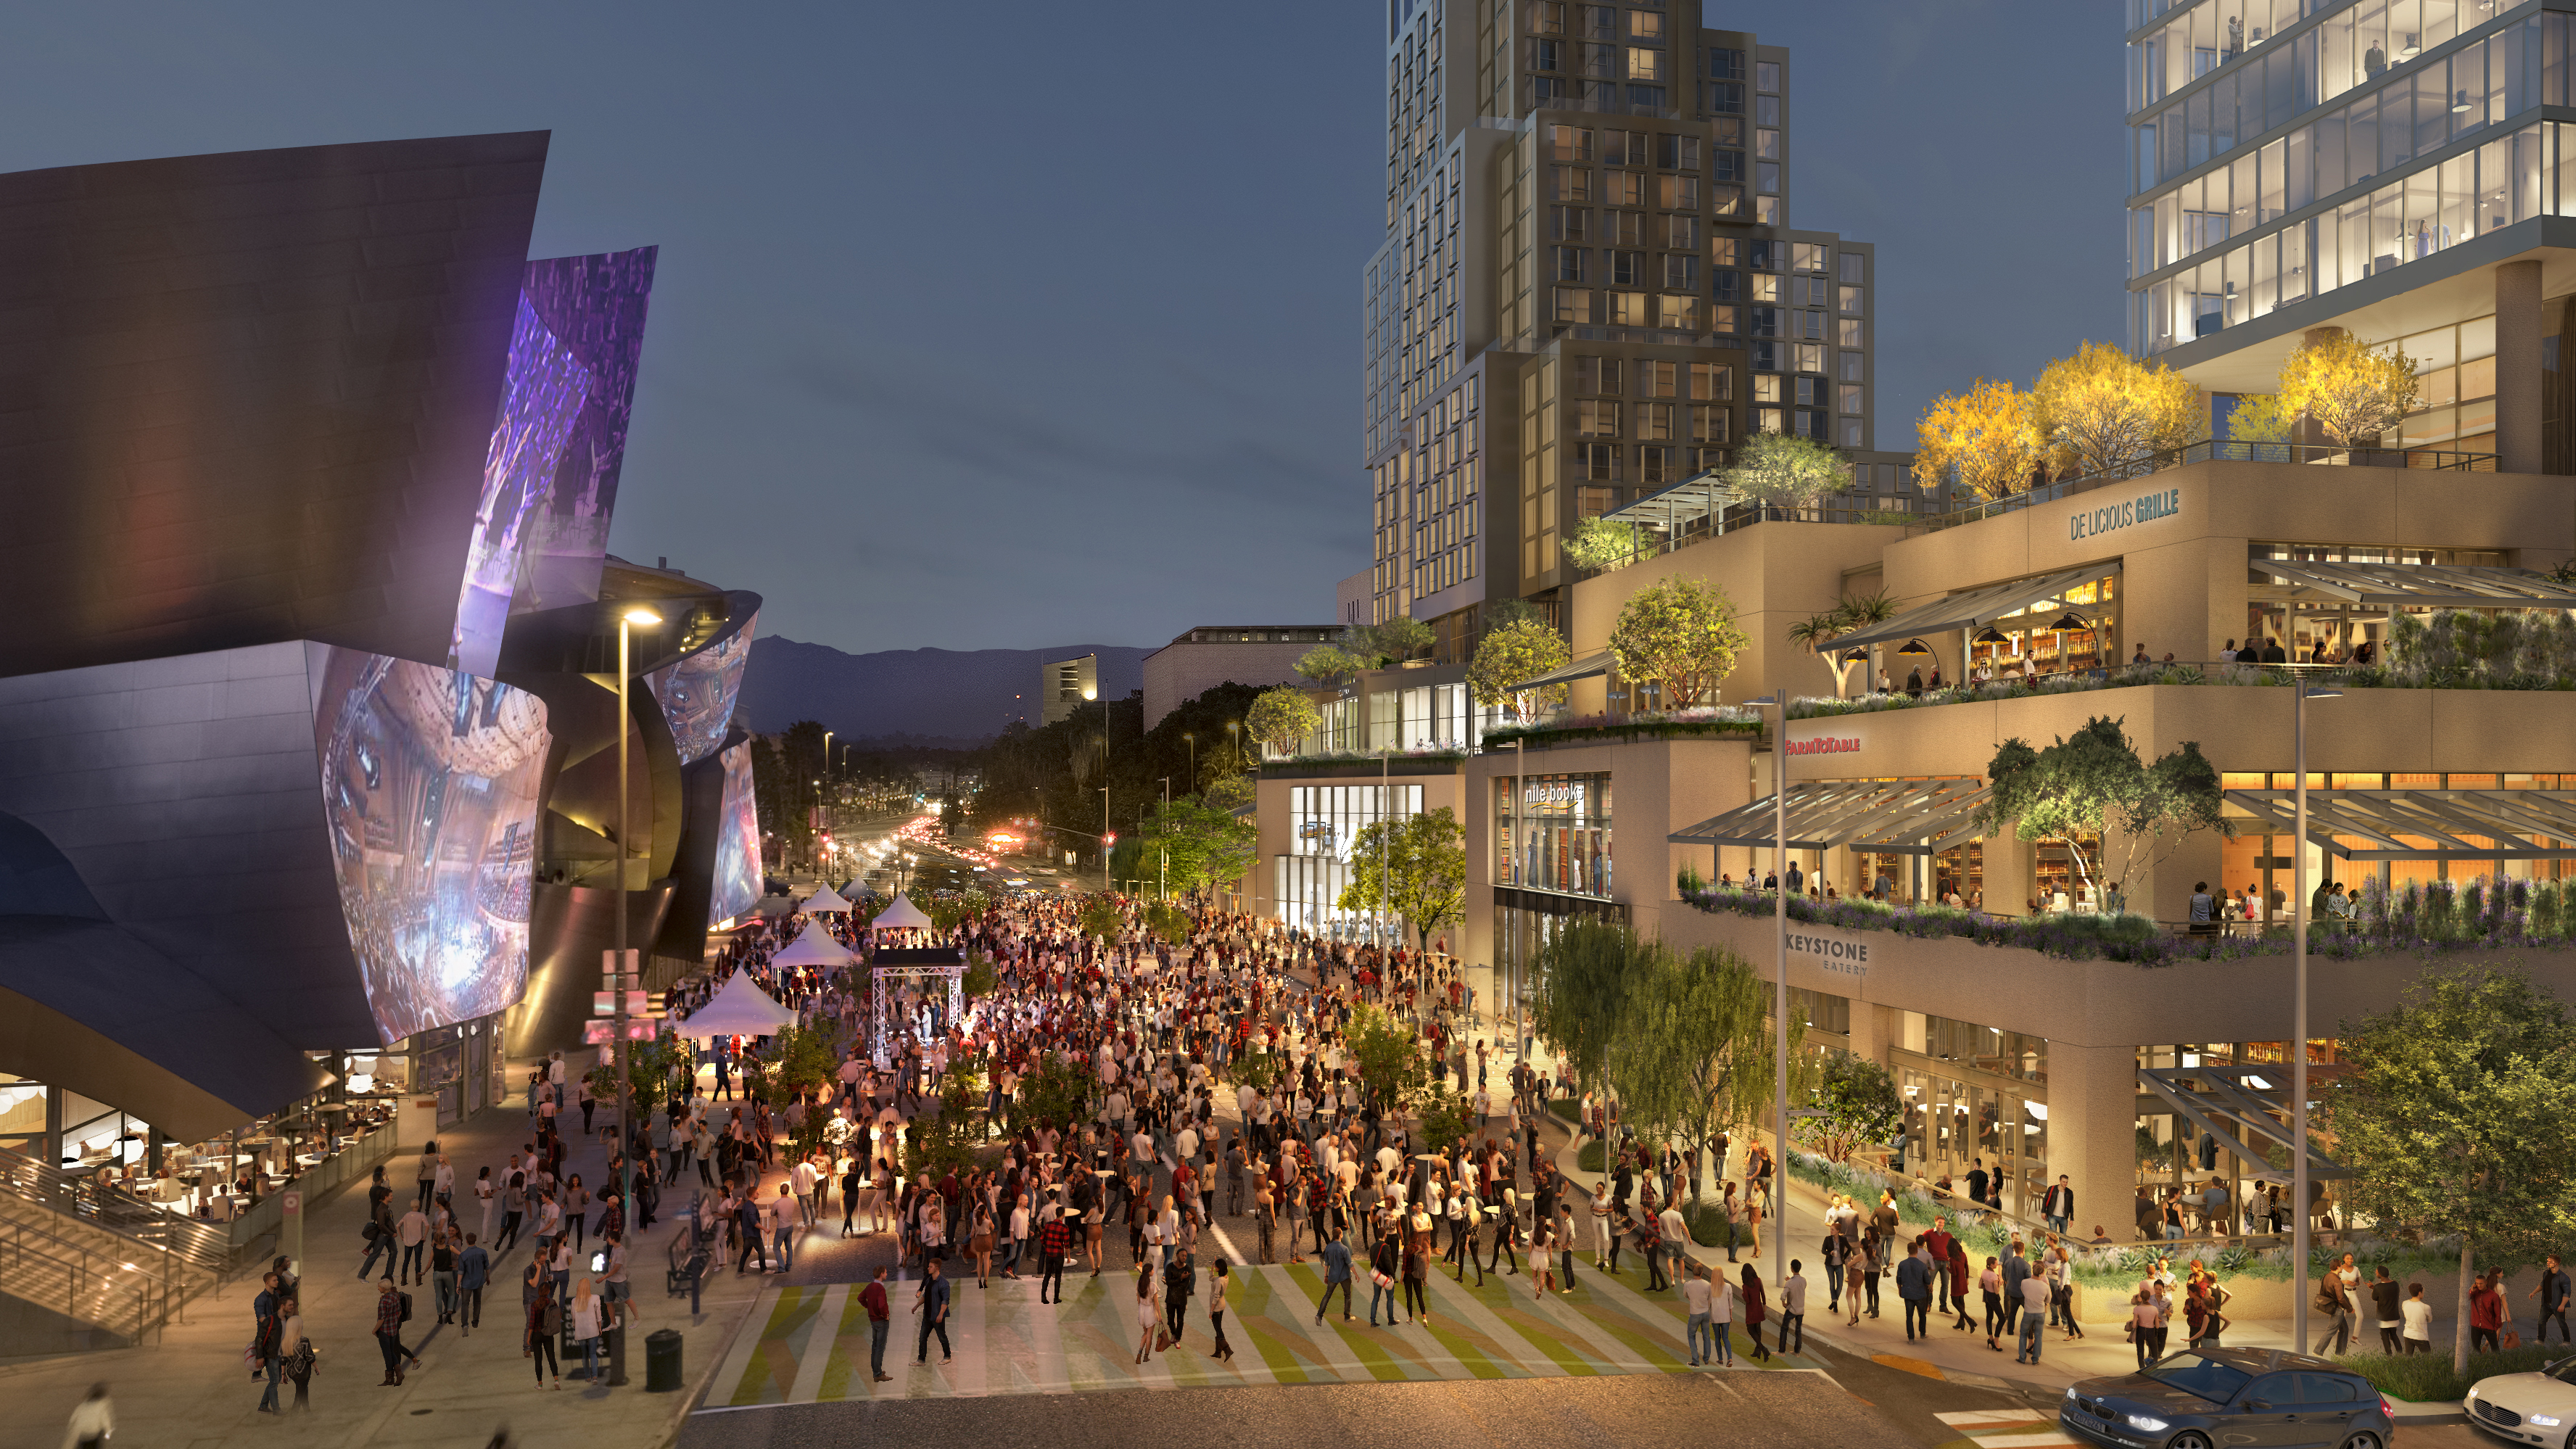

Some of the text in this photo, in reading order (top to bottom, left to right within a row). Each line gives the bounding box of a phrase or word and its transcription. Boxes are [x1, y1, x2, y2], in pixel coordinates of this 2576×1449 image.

[2071, 488, 2179, 540] DE LICIOUS GRILLE
[1525, 783, 1584, 803] nile books
[1786, 933, 1867, 962] KEYSTONE
[1823, 960, 1867, 976] EATERY
